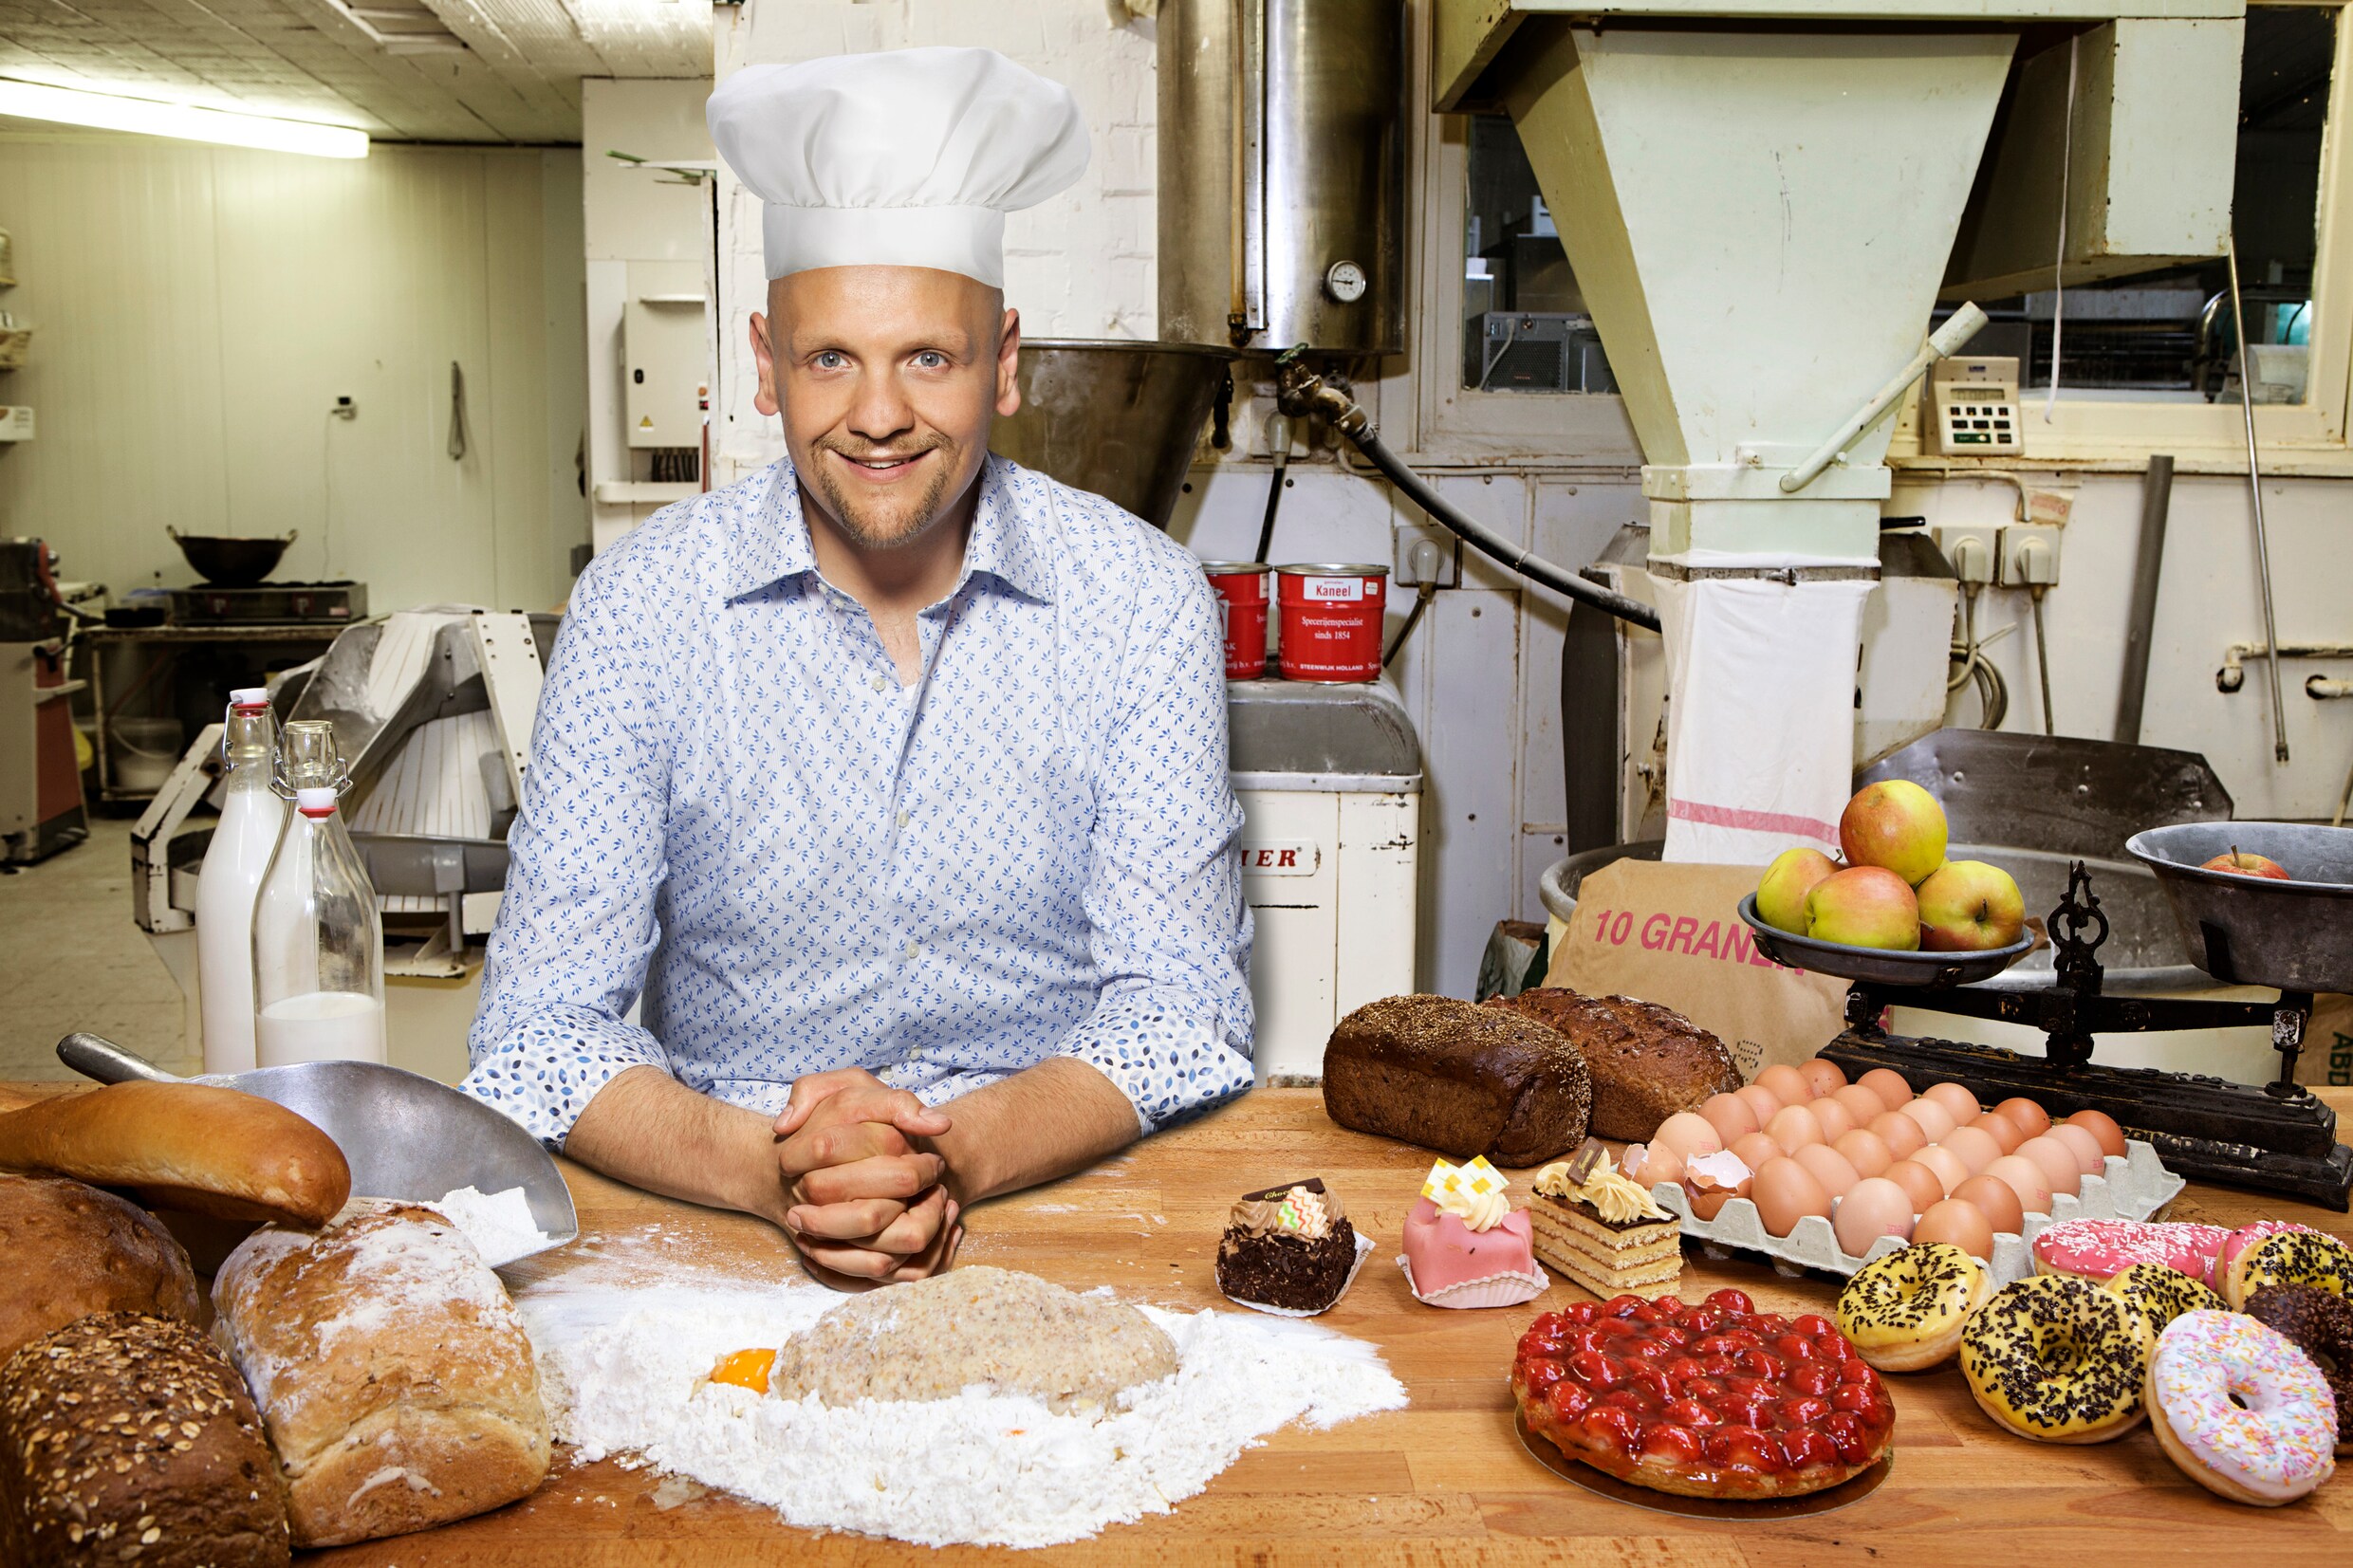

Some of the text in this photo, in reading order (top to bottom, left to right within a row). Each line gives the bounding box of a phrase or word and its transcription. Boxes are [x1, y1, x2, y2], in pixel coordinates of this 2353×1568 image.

[1316, 584, 1351, 598] Kaneel
[1302, 616, 1363, 628] Specerijenspecialist
[1314, 630, 1350, 639] sinds 1854
[1595, 910, 1805, 976] 10 GRAN
